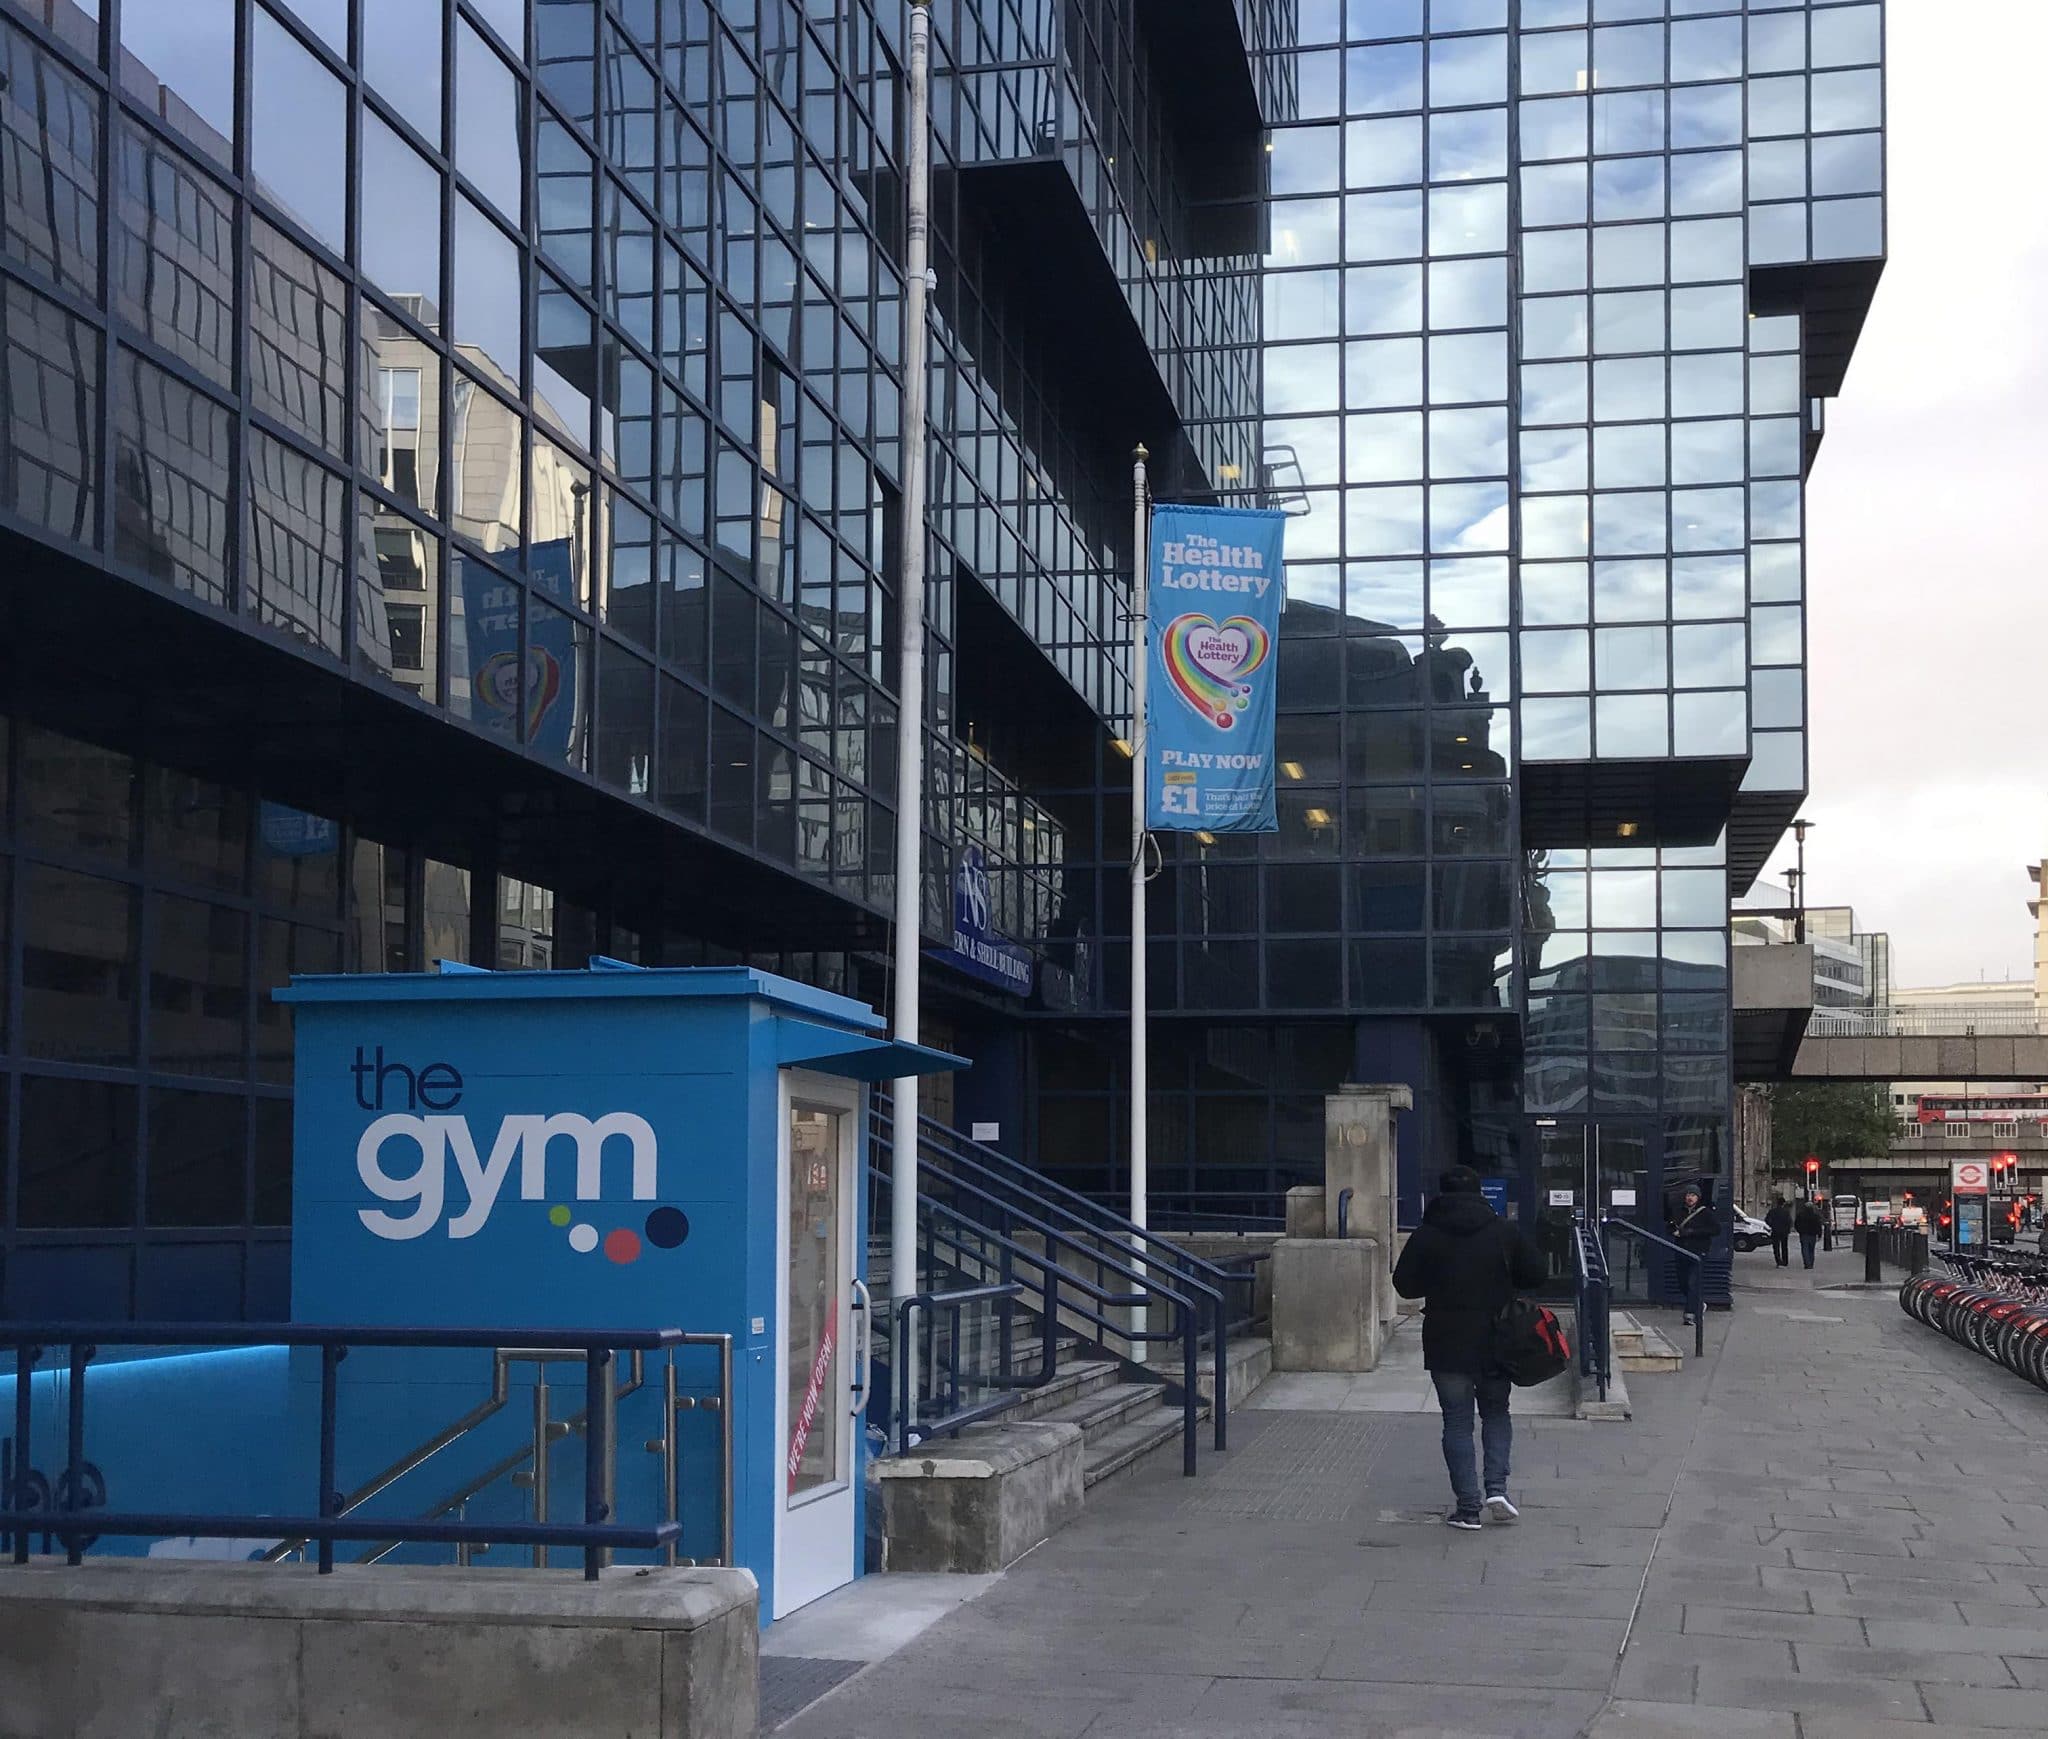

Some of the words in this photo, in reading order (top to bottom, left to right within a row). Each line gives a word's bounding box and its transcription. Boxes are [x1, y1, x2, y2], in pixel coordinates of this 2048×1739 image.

[1162, 541, 1263, 569] Health
[1186, 534, 1218, 548] The
[1161, 565, 1271, 598] Lottery
[1198, 650, 1240, 664] Lottery
[1200, 641, 1238, 652] Health
[1161, 749, 1213, 768] PLAY
[1215, 754, 1263, 769] NOW
[1161, 784, 1200, 815] £1
[351, 1046, 463, 1111] the
[357, 1111, 658, 1240] gym
[788, 1420, 808, 1476] WE'RE
[802, 1379, 820, 1427] NOW
